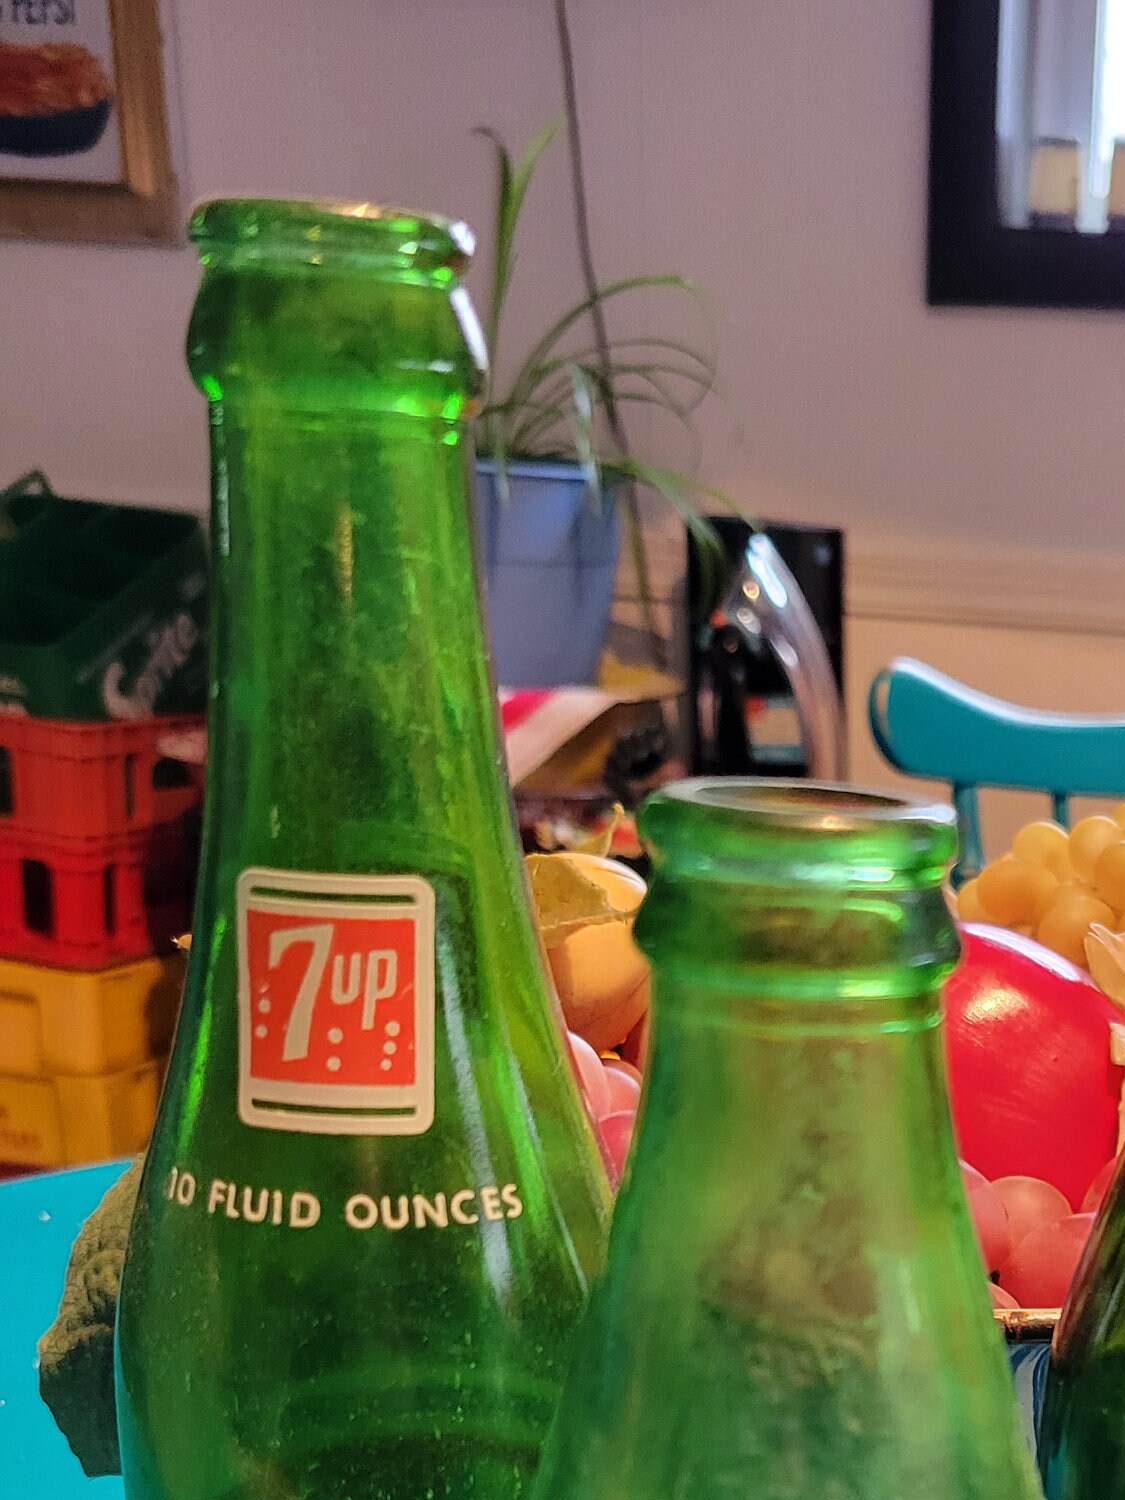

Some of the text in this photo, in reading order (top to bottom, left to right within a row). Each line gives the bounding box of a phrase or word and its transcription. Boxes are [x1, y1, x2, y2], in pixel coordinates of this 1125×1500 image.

[166, 1167, 524, 1231] 10 FLUID OUNCES
